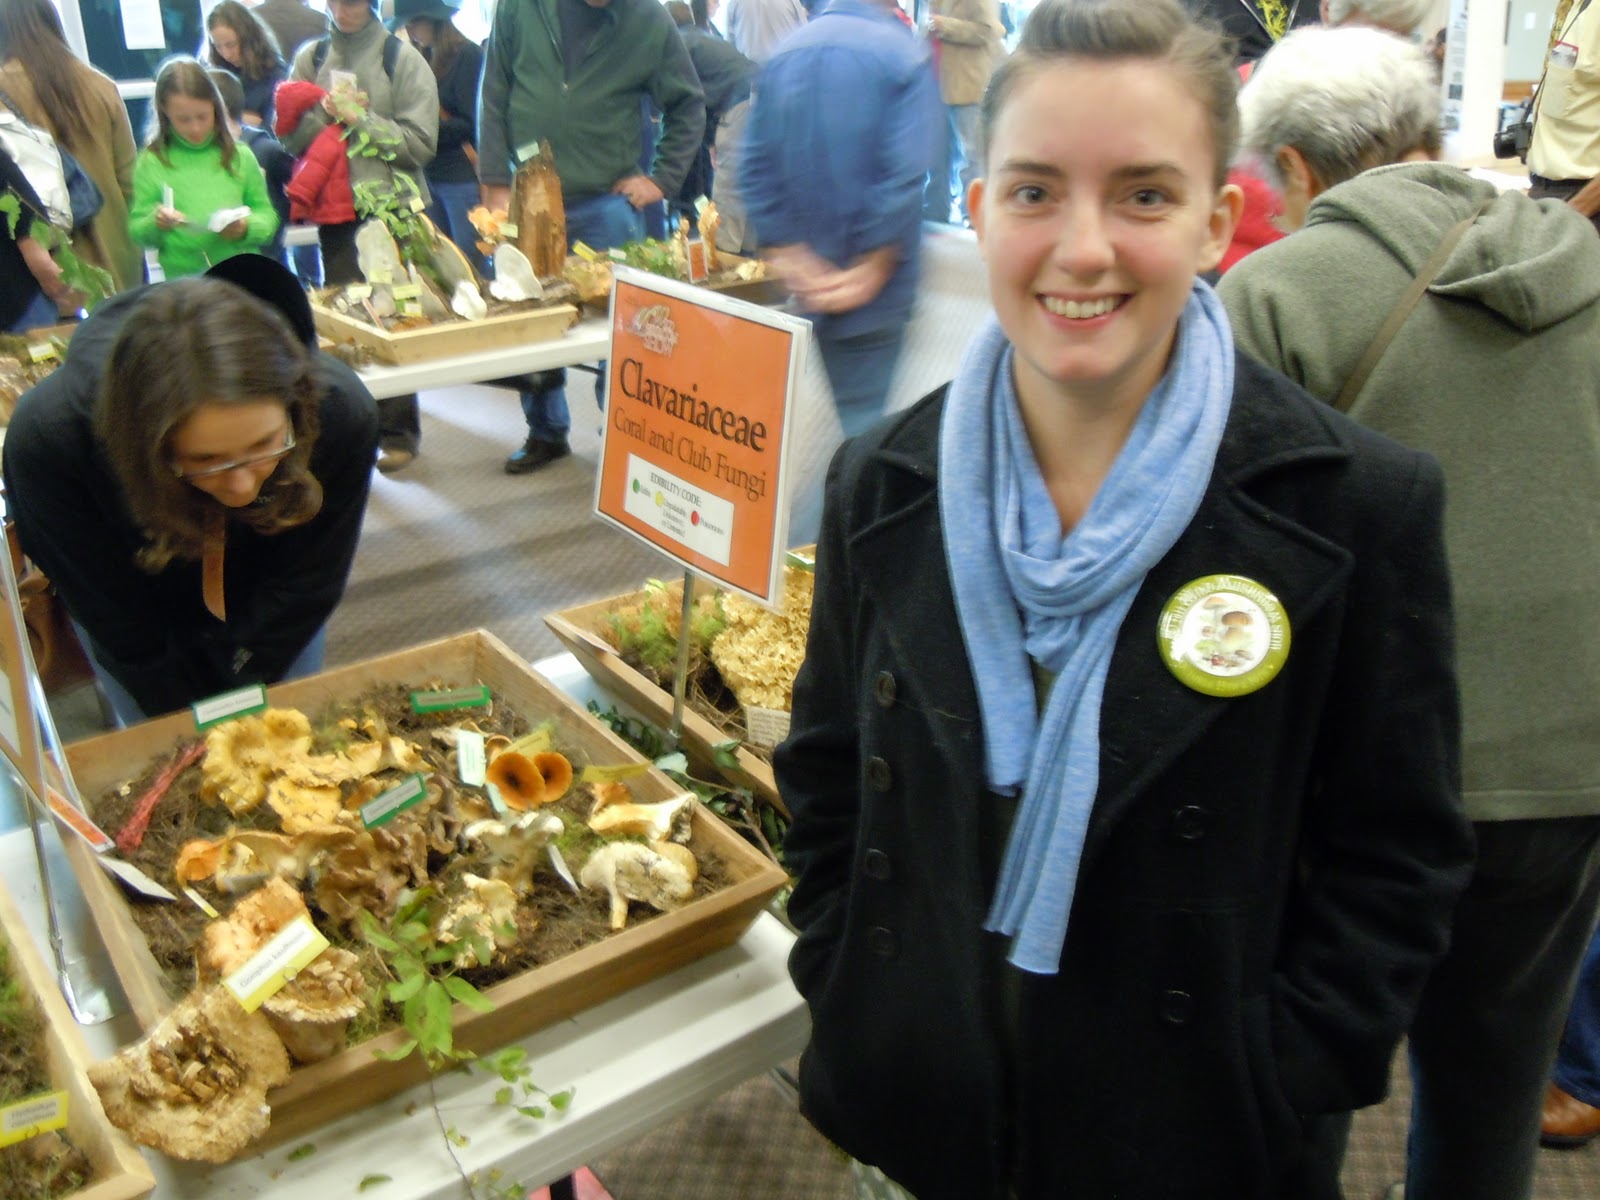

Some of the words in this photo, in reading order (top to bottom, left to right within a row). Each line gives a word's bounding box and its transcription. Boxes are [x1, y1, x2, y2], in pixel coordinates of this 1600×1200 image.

[619, 357, 767, 453] Clavariaceae
[614, 406, 646, 442] Coral
[649, 429, 674, 456] and
[678, 436, 712, 473] Club
[715, 452, 767, 502] Fungi
[650, 472, 681, 497] EDIBILITY
